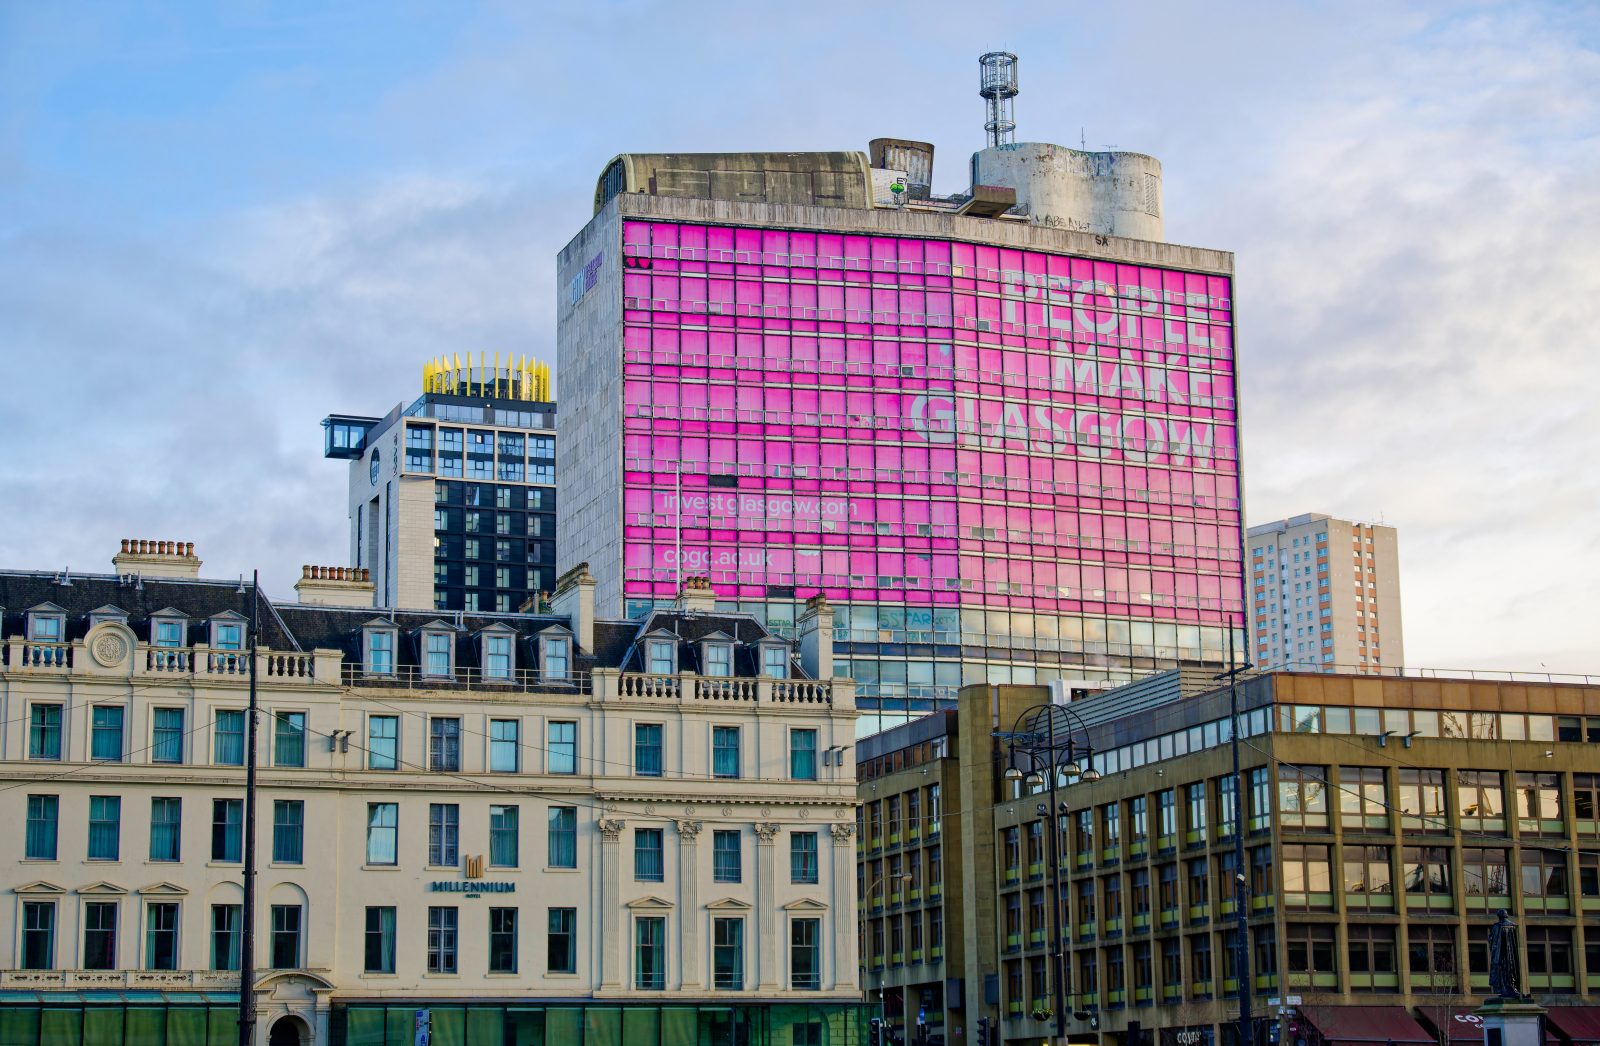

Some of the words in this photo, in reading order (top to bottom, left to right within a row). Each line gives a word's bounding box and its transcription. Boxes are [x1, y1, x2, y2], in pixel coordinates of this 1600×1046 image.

[1001, 268, 1216, 348] PEOPLE
[1055, 340, 1216, 407] MAKE
[910, 387, 1215, 468] GLASGOW
[432, 881, 516, 893] MILLENNIUM
